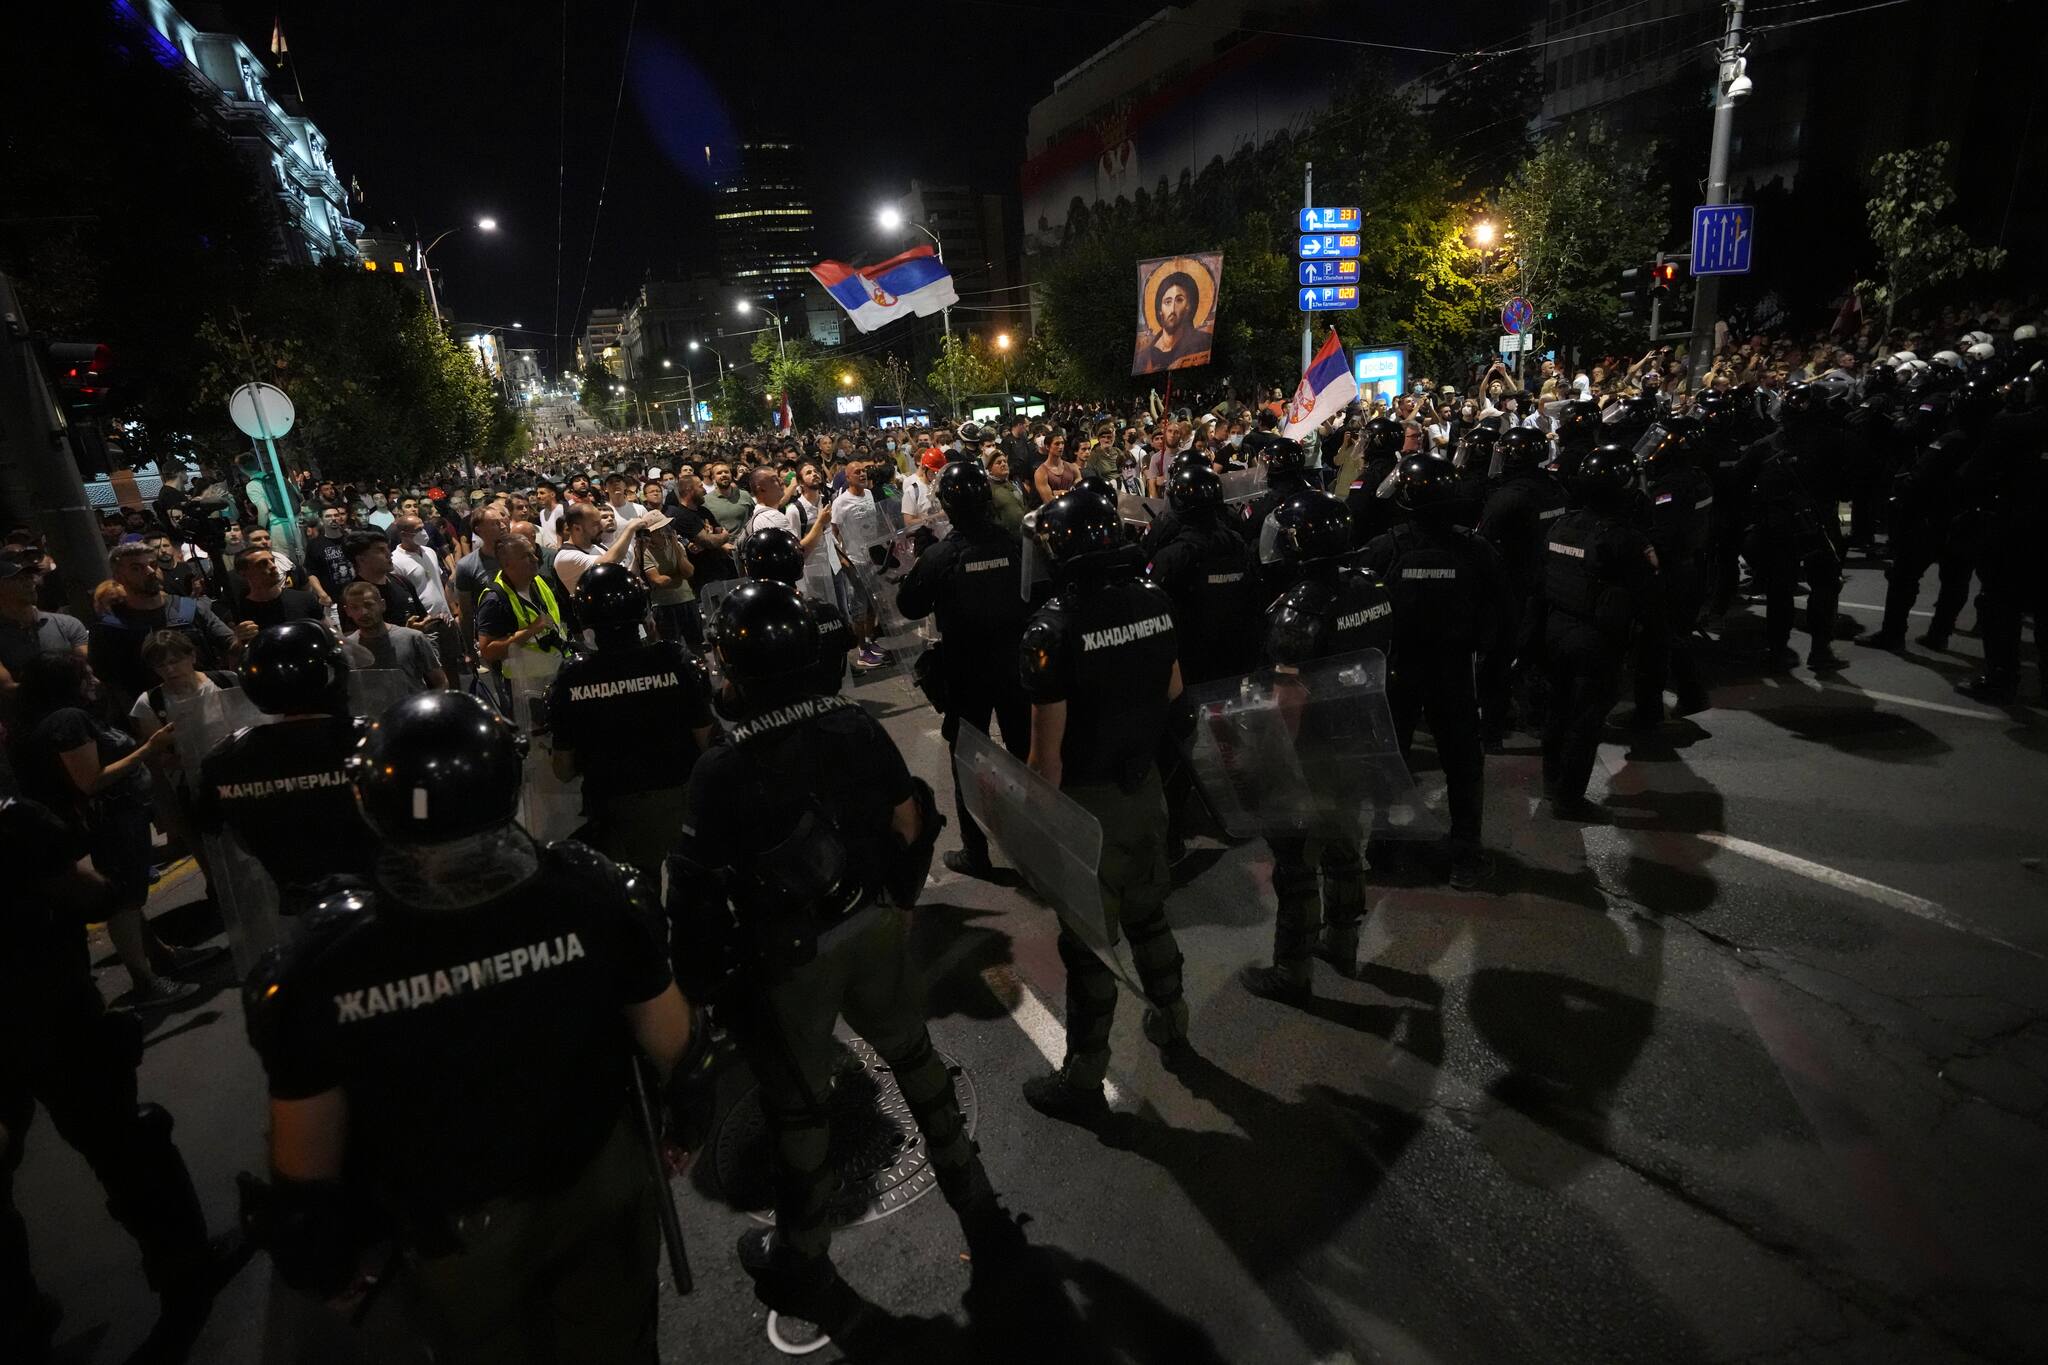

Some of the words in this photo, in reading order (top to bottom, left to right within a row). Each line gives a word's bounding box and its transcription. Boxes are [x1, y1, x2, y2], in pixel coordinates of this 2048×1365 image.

[1341, 209, 1357, 220] 331
[1339, 262, 1356, 273] 200
[1338, 288, 1355, 299] 020
[1081, 613, 1175, 652] ЖАНДАРМЕРИЈА
[570, 671, 680, 702] ЖАНДАРМЕРИЈА
[333, 932, 586, 1024] ЖАНДАРМЕРИЈА
